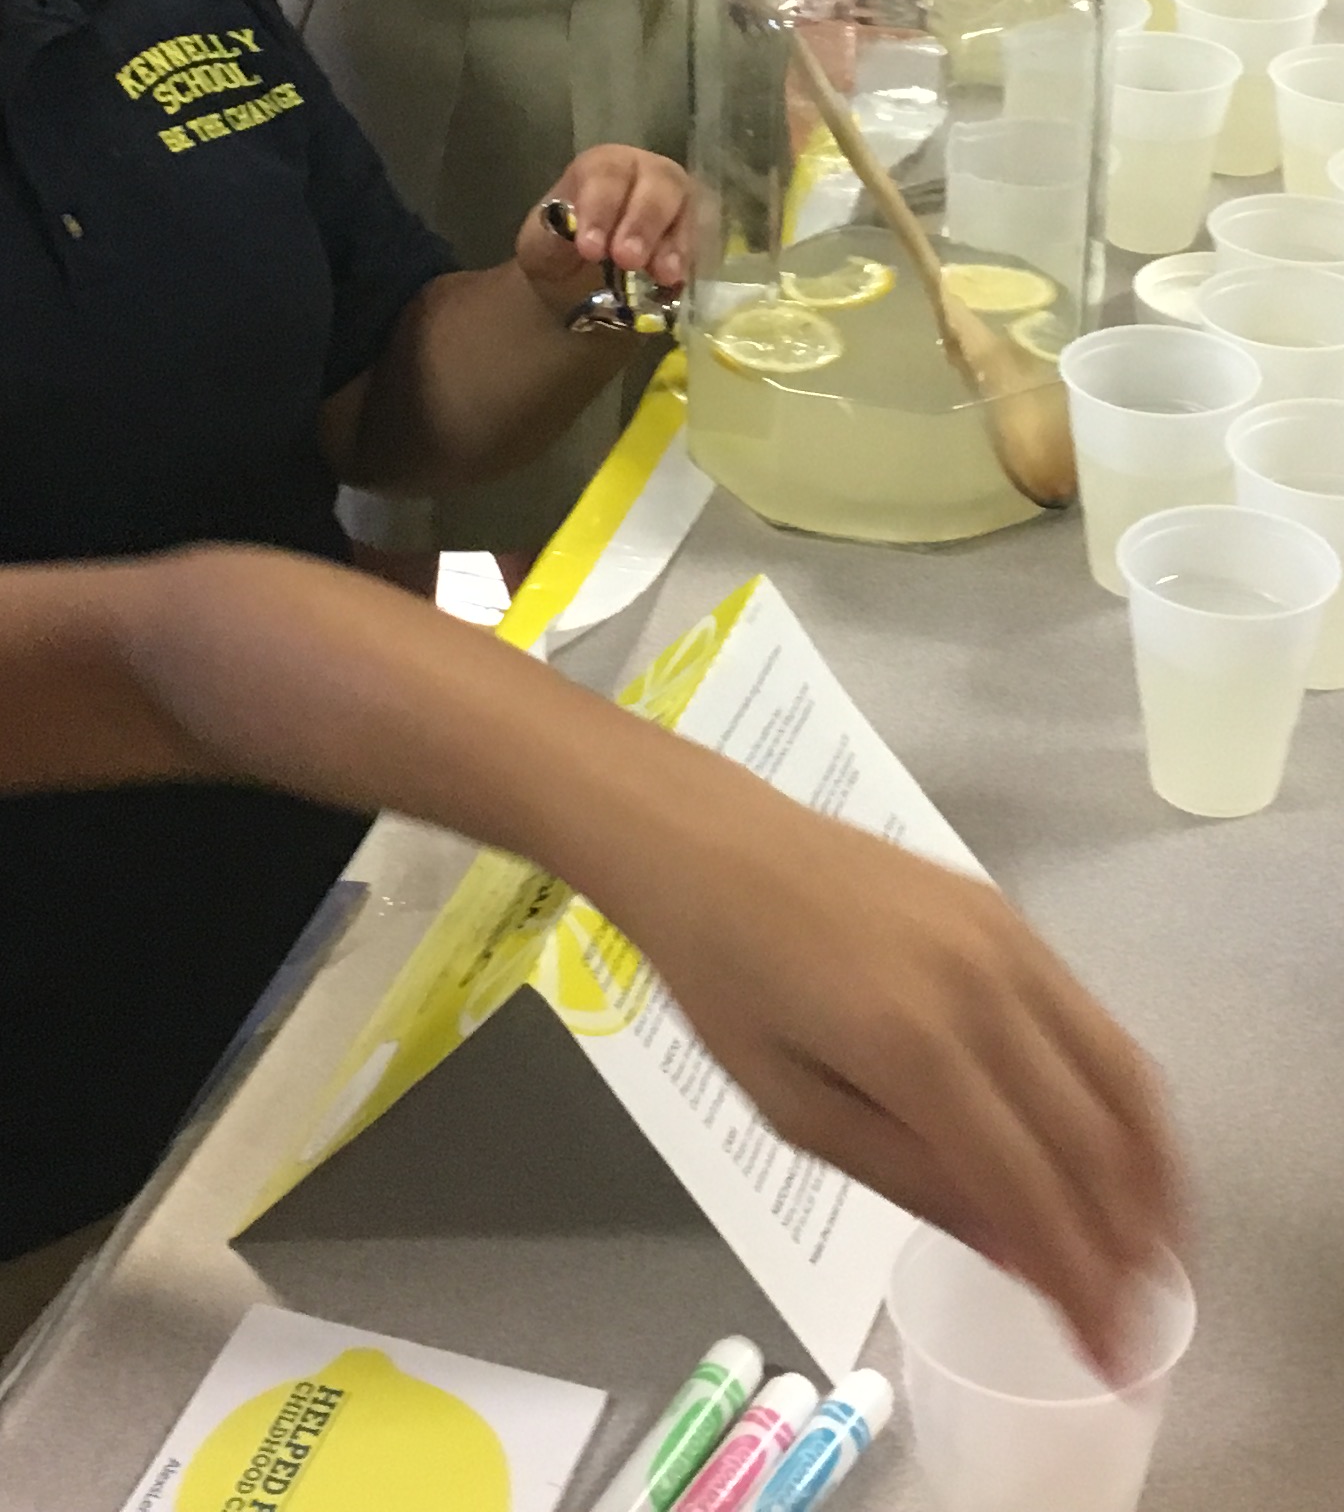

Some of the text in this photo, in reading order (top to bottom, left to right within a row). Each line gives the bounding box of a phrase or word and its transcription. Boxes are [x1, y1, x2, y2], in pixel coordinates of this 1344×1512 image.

[115, 28, 263, 99] KENNELLY
[153, 62, 262, 115] SCHOOL
[234, 1381, 317, 1495] CHILDHOOD
[262, 1384, 345, 1496] HELPED
